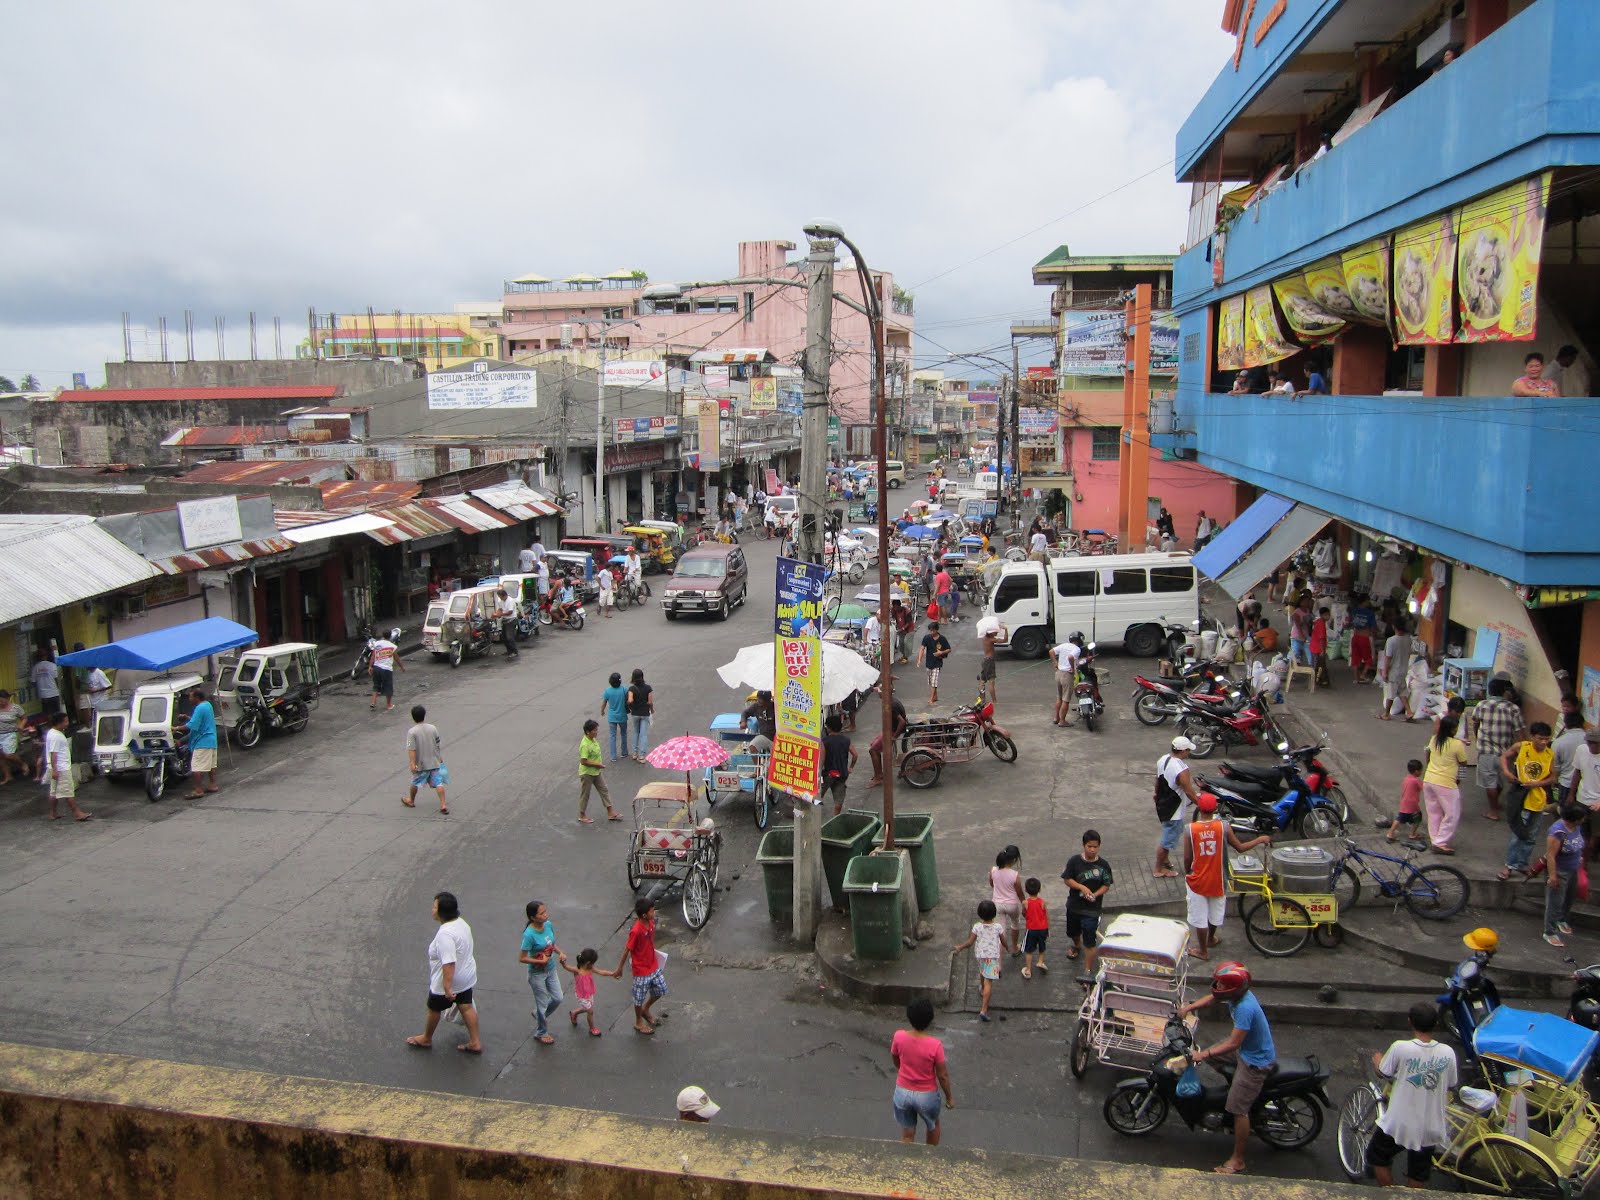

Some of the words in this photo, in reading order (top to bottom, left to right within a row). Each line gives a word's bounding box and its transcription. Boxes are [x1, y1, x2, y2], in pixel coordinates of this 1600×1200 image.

[1087, 313, 1159, 323] WELCE
[433, 374, 463, 383] CASTILLON
[465, 373, 490, 382] TRADING
[490, 372, 531, 381] CORPORATION
[651, 418, 662, 427] TCL
[785, 656, 810, 664] REE
[788, 680, 802, 688] Win
[792, 694, 812, 707] PACKS
[774, 740, 803, 756] BUY
[806, 748, 814, 760] 1
[788, 755, 814, 768] CHICKEN
[776, 762, 803, 778] GET
[808, 770, 814, 782] 1
[718, 776, 738, 785] 0215
[794, 778, 814, 791] MANOK
[1198, 840, 1216, 856] 13
[644, 862, 666, 872] 0892
